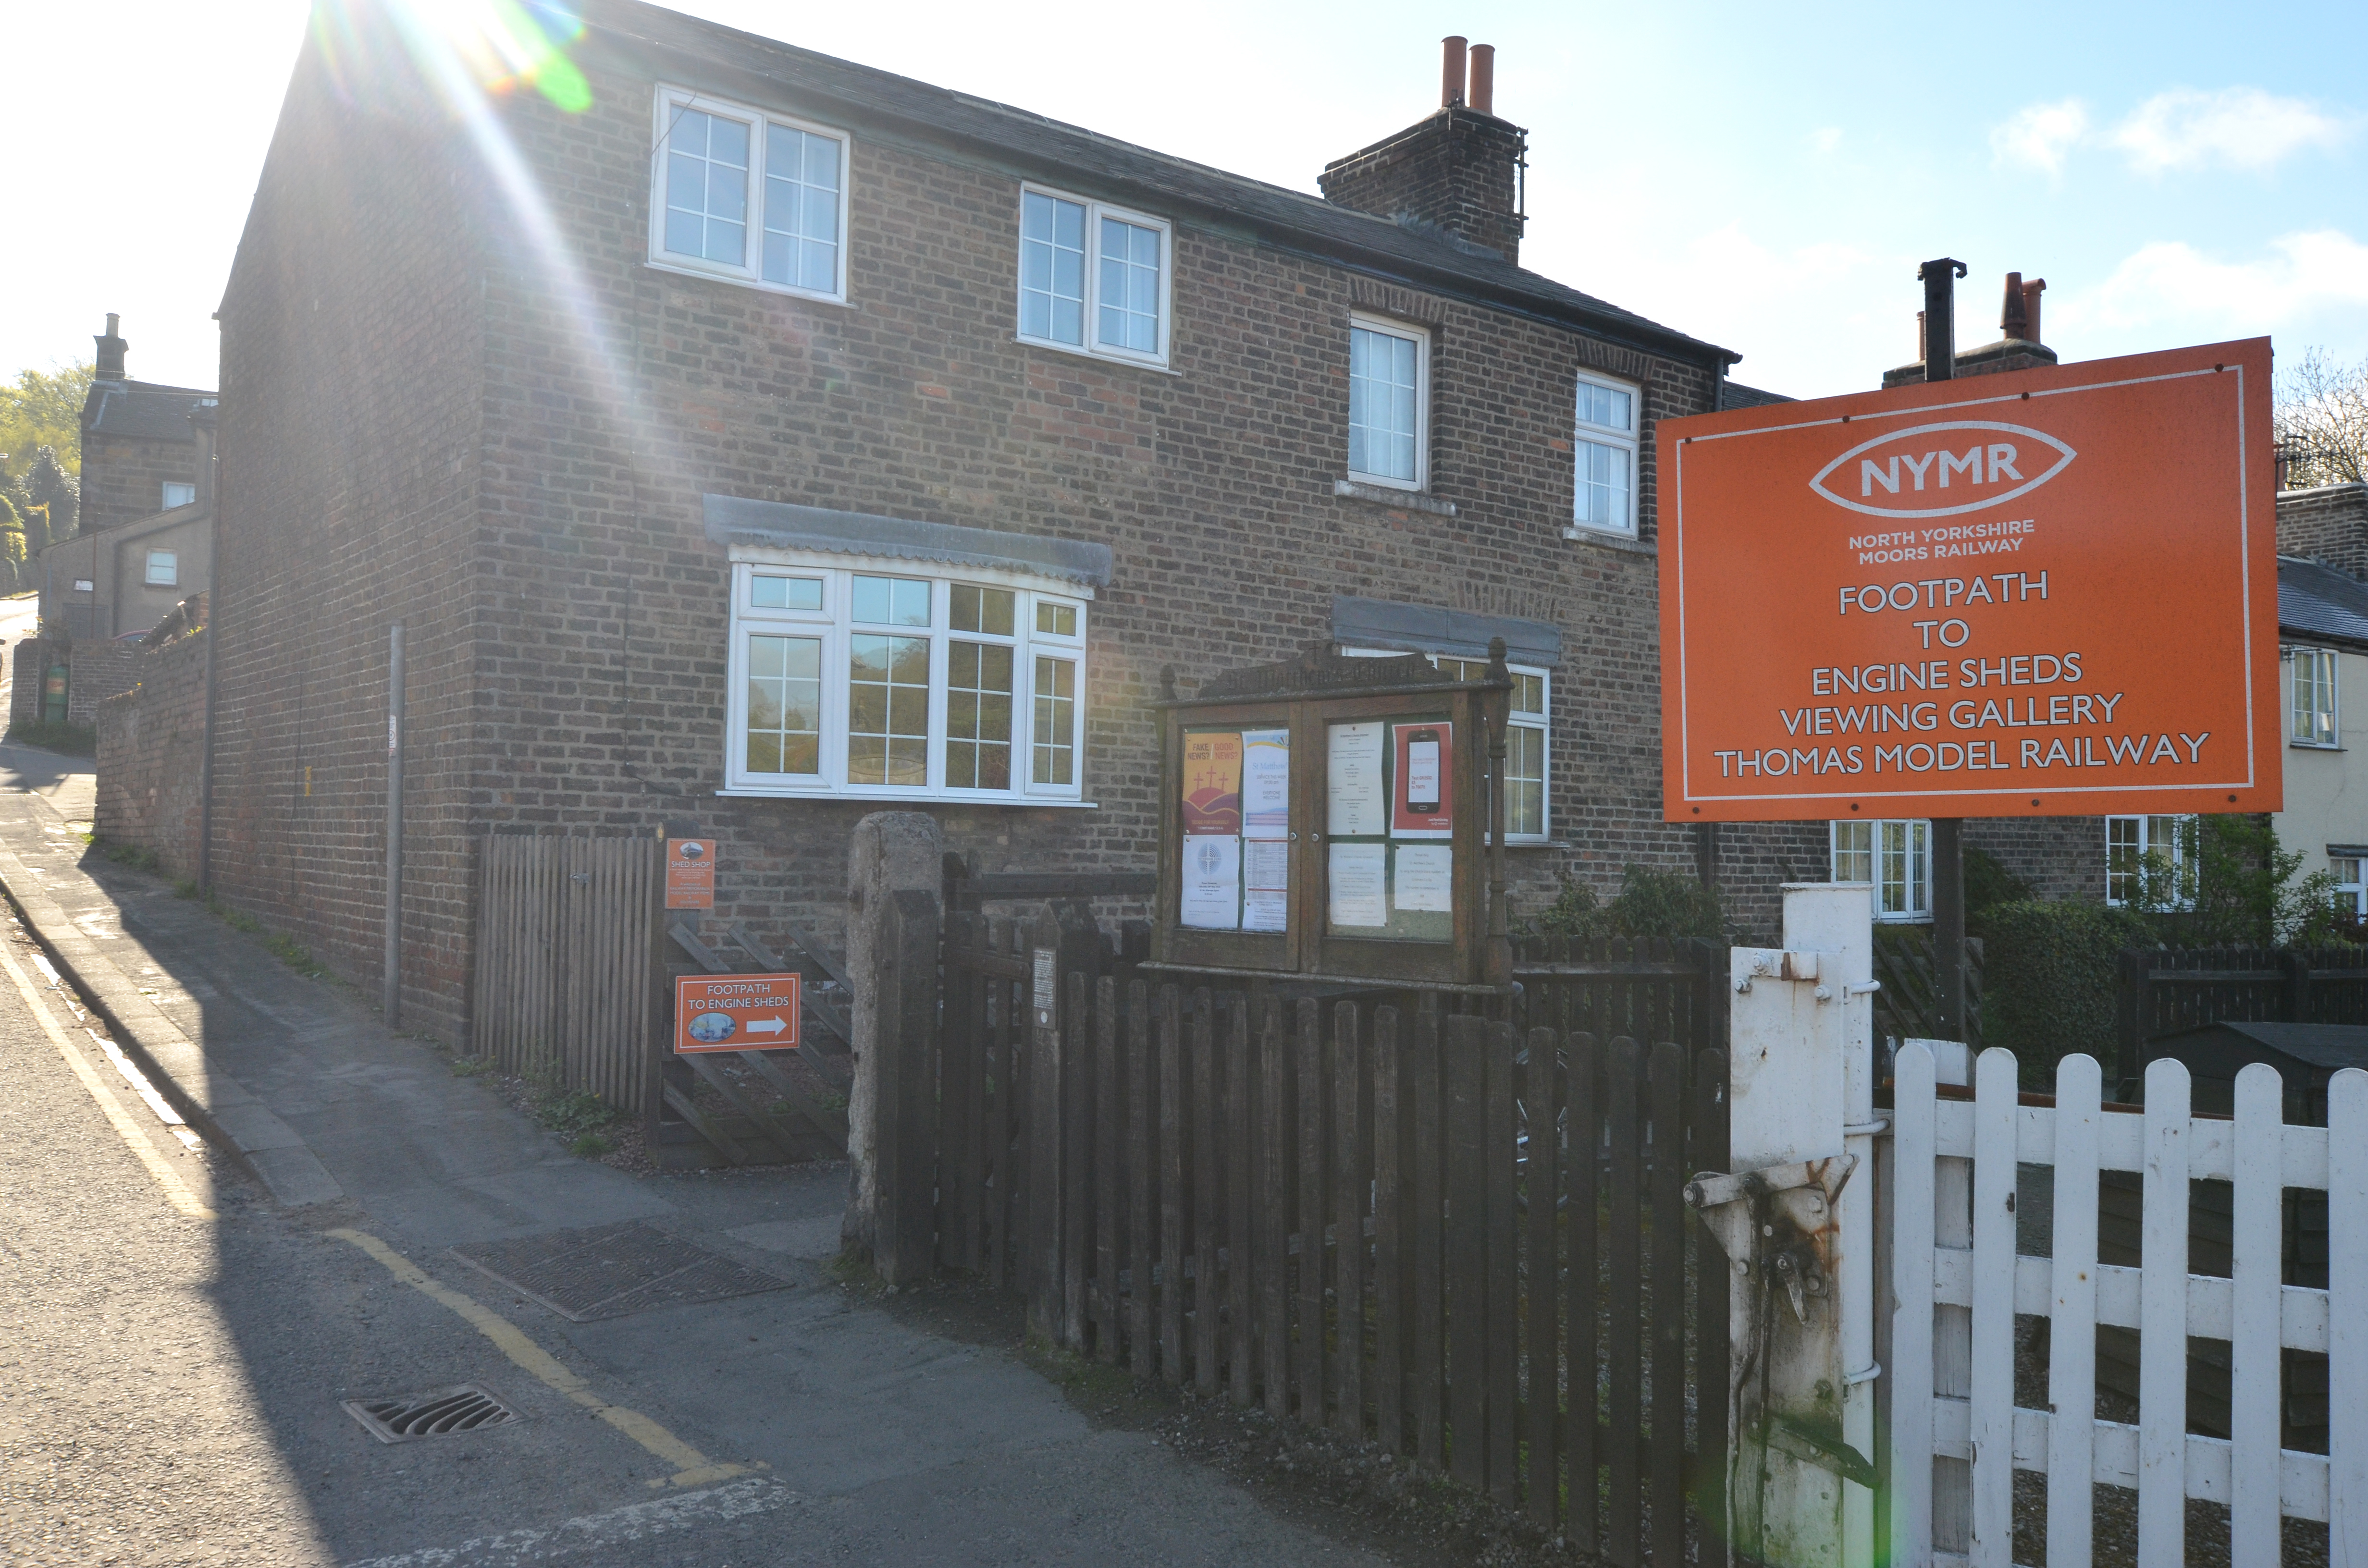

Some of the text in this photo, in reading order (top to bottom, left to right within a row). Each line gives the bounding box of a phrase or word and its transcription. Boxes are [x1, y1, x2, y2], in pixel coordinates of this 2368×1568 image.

[1861, 443, 2024, 497] NYMR
[1849, 518, 2035, 551] NORTH YORKSHIRE
[1858, 538, 2024, 565] MOORS RAILWAY
[1839, 570, 2048, 615] FOOTPATH
[1912, 619, 1970, 649] TO
[1812, 652, 2083, 696] ENGINE SHEDS
[1779, 693, 2123, 736] VIEWING GALLERY
[1713, 733, 2210, 778] THOMAS MODEL RAILWAY
[687, 996, 789, 1010] TO ENGINE SHEDS
[707, 983, 771, 995] FOOTPATH
